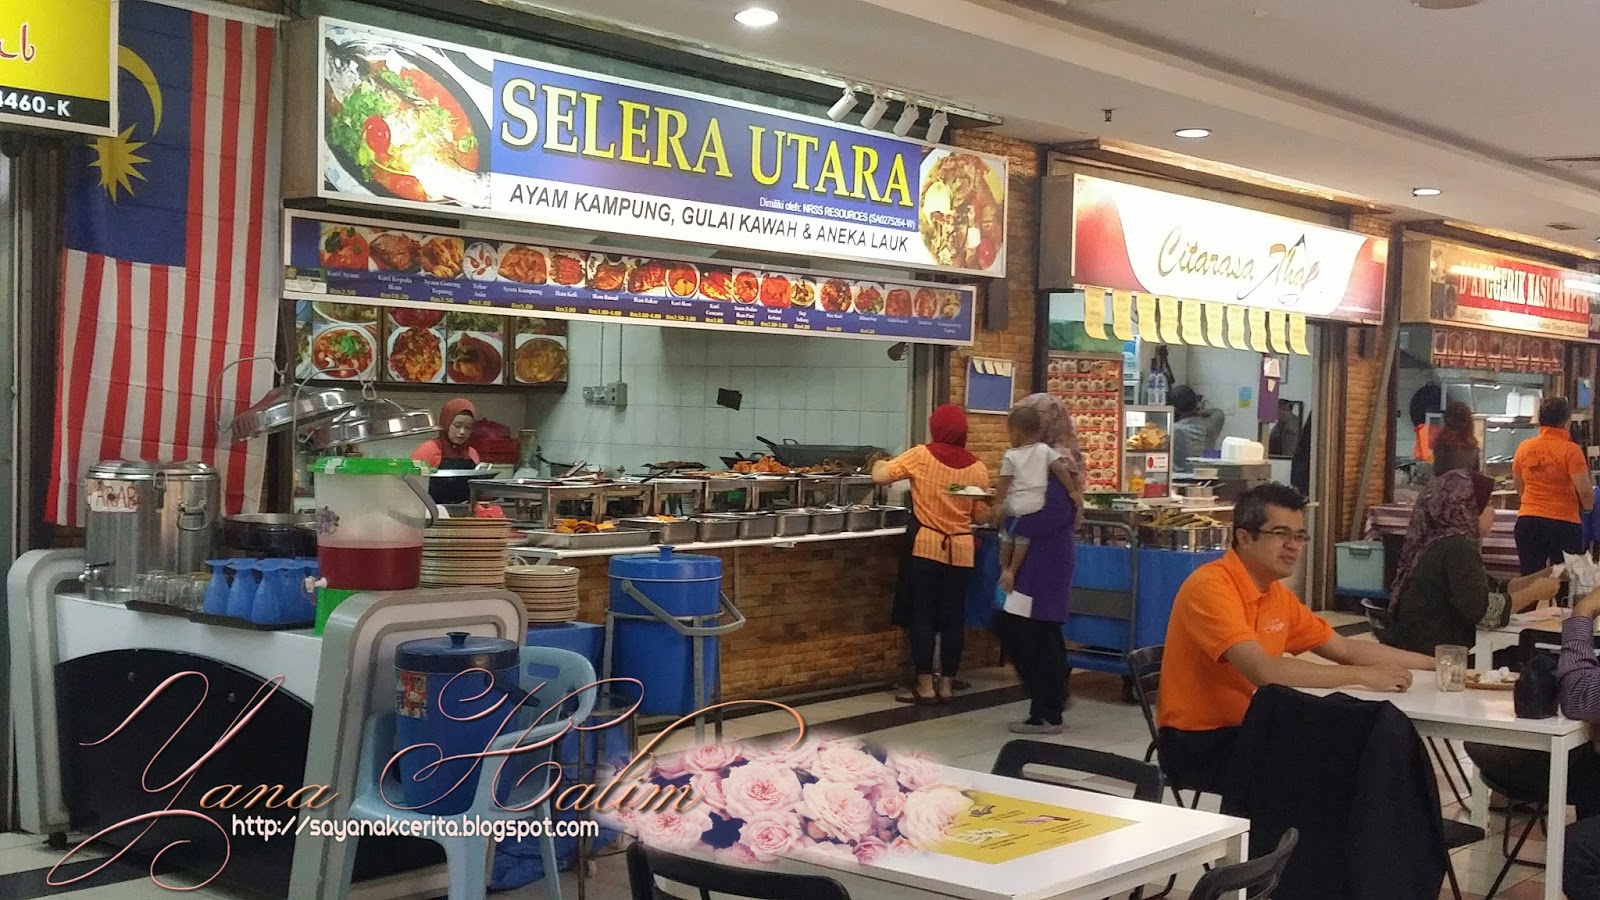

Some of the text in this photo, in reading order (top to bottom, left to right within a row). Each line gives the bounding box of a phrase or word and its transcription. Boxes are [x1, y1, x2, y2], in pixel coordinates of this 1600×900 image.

[0, 91, 70, 117] 460-K
[500, 78, 914, 208] SELERA UTARA
[510, 183, 909, 252] AYAM KAMPUNG, GULAI KAWAH & ANEKA LAUK
[759, 197, 784, 210] Dimiliki
[803, 203, 824, 216] NRSS
[824, 206, 869, 222] RESOURCES
[1157, 226, 1255, 281] Citarasa
[1527, 272, 1551, 308] NASI
